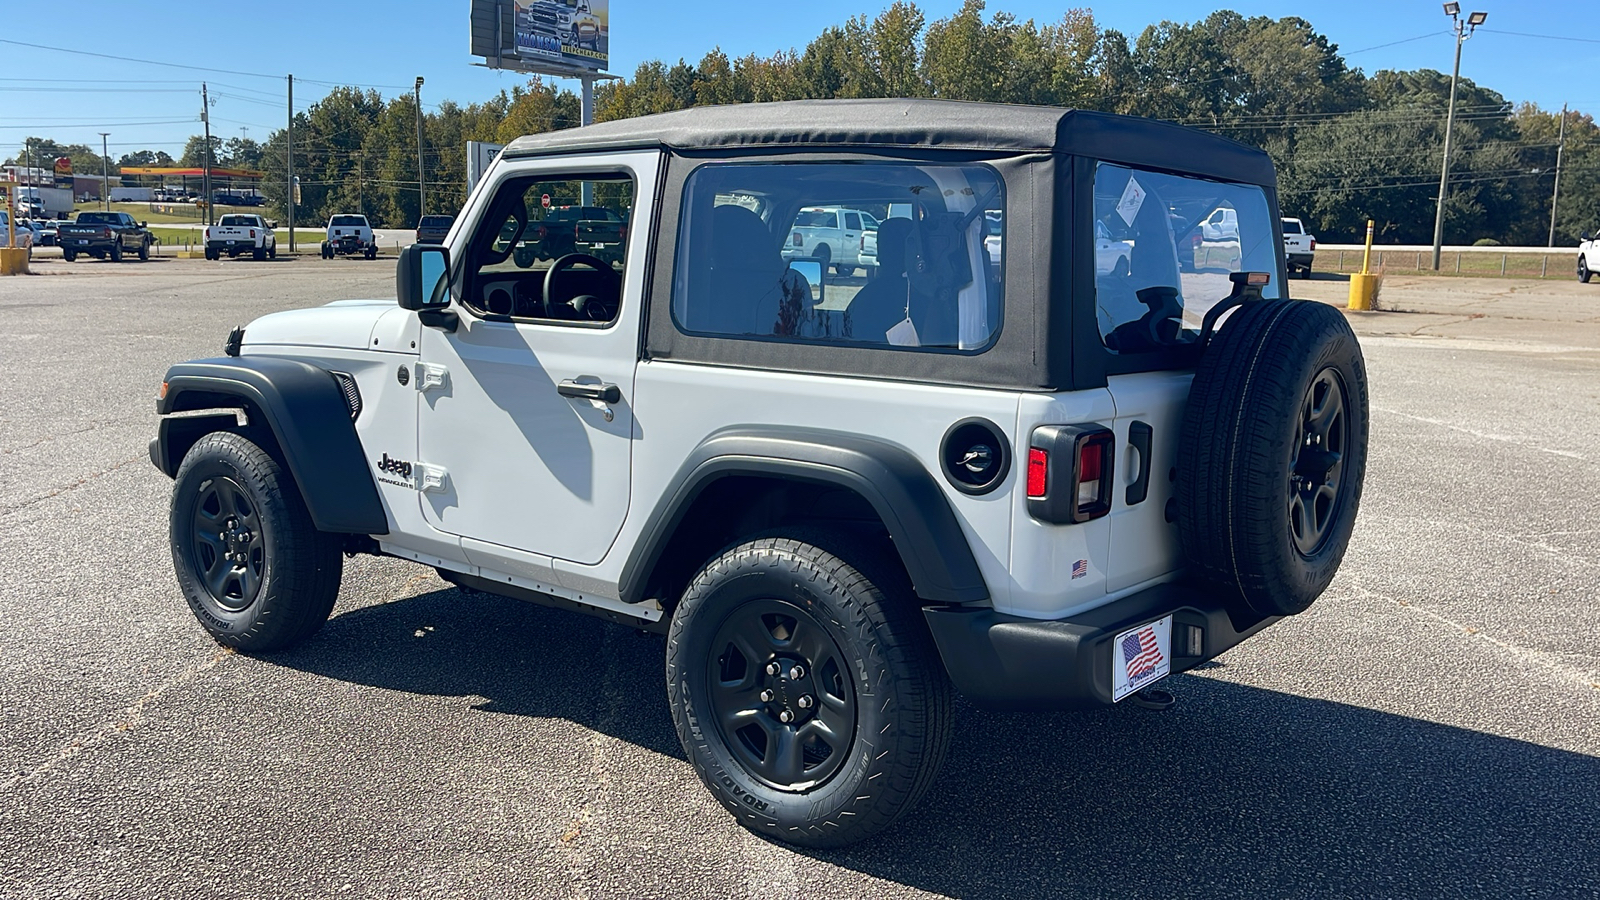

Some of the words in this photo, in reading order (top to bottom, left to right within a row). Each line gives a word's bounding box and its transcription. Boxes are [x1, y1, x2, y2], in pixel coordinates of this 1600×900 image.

[518, 32, 562, 51] THOMSON
[562, 46, 607, 59] JEEPCHEAP.COM
[377, 453, 412, 479] Jeep
[378, 477, 408, 488] WRANGLER
